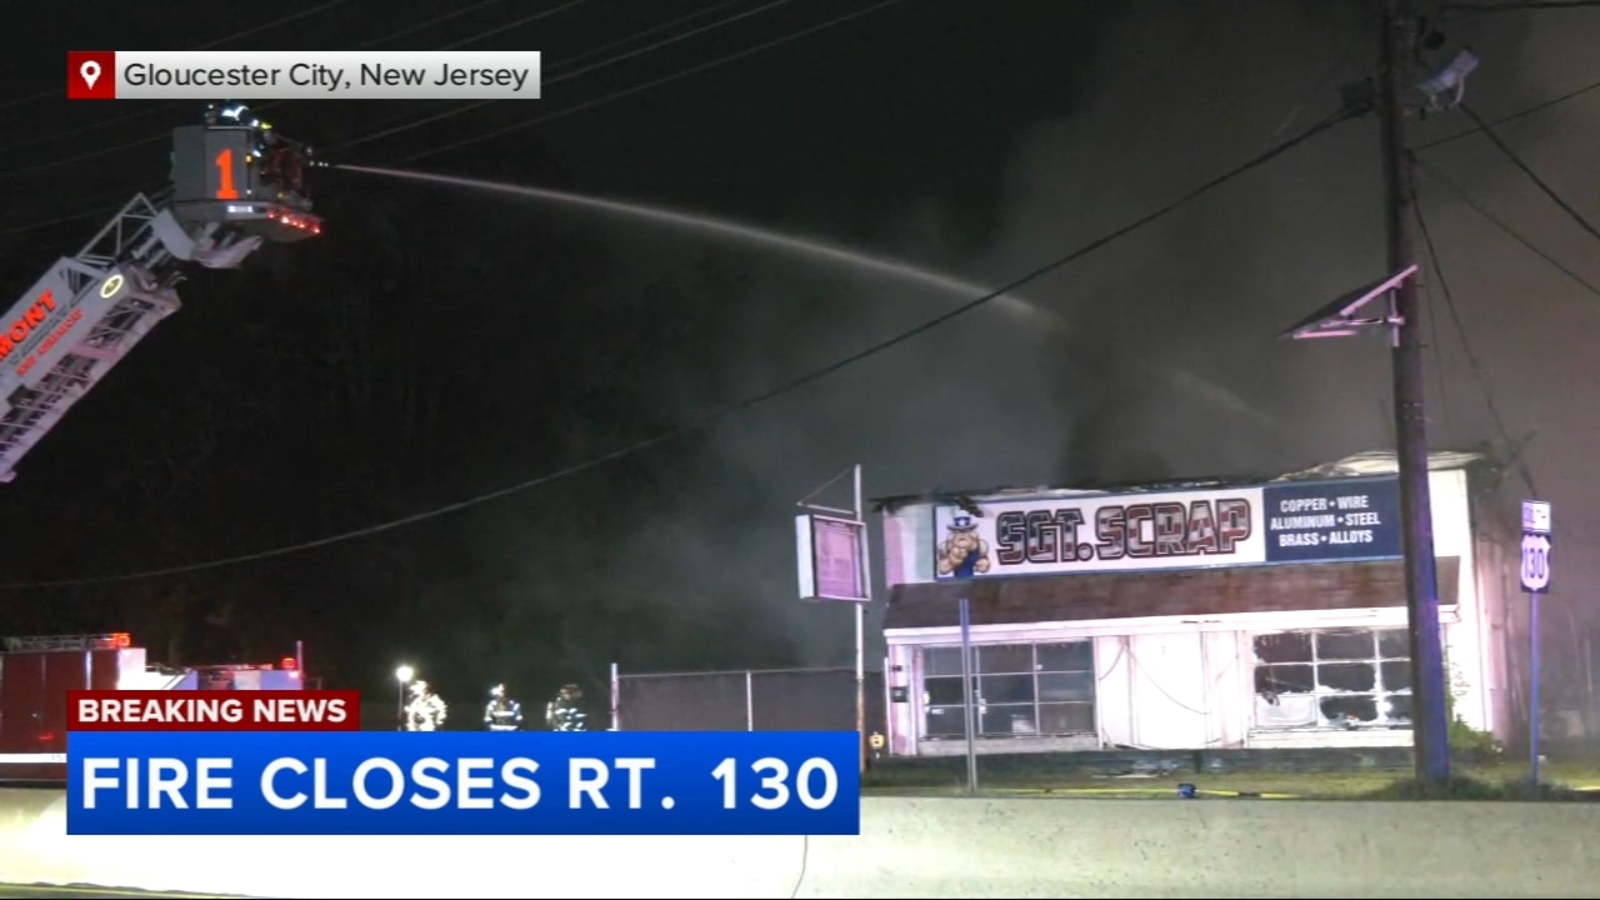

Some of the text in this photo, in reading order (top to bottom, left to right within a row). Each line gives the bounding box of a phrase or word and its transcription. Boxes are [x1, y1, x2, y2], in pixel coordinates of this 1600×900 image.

[215, 148, 240, 200] 1
[1280, 495, 1369, 512] COPPER WIRE
[996, 498, 1252, 565] SGT. SCRAP
[1270, 512, 1381, 530] ALUMINUM STEEL
[1279, 530, 1373, 547] BRASS ALLOYS
[1524, 547, 1545, 579] 130
